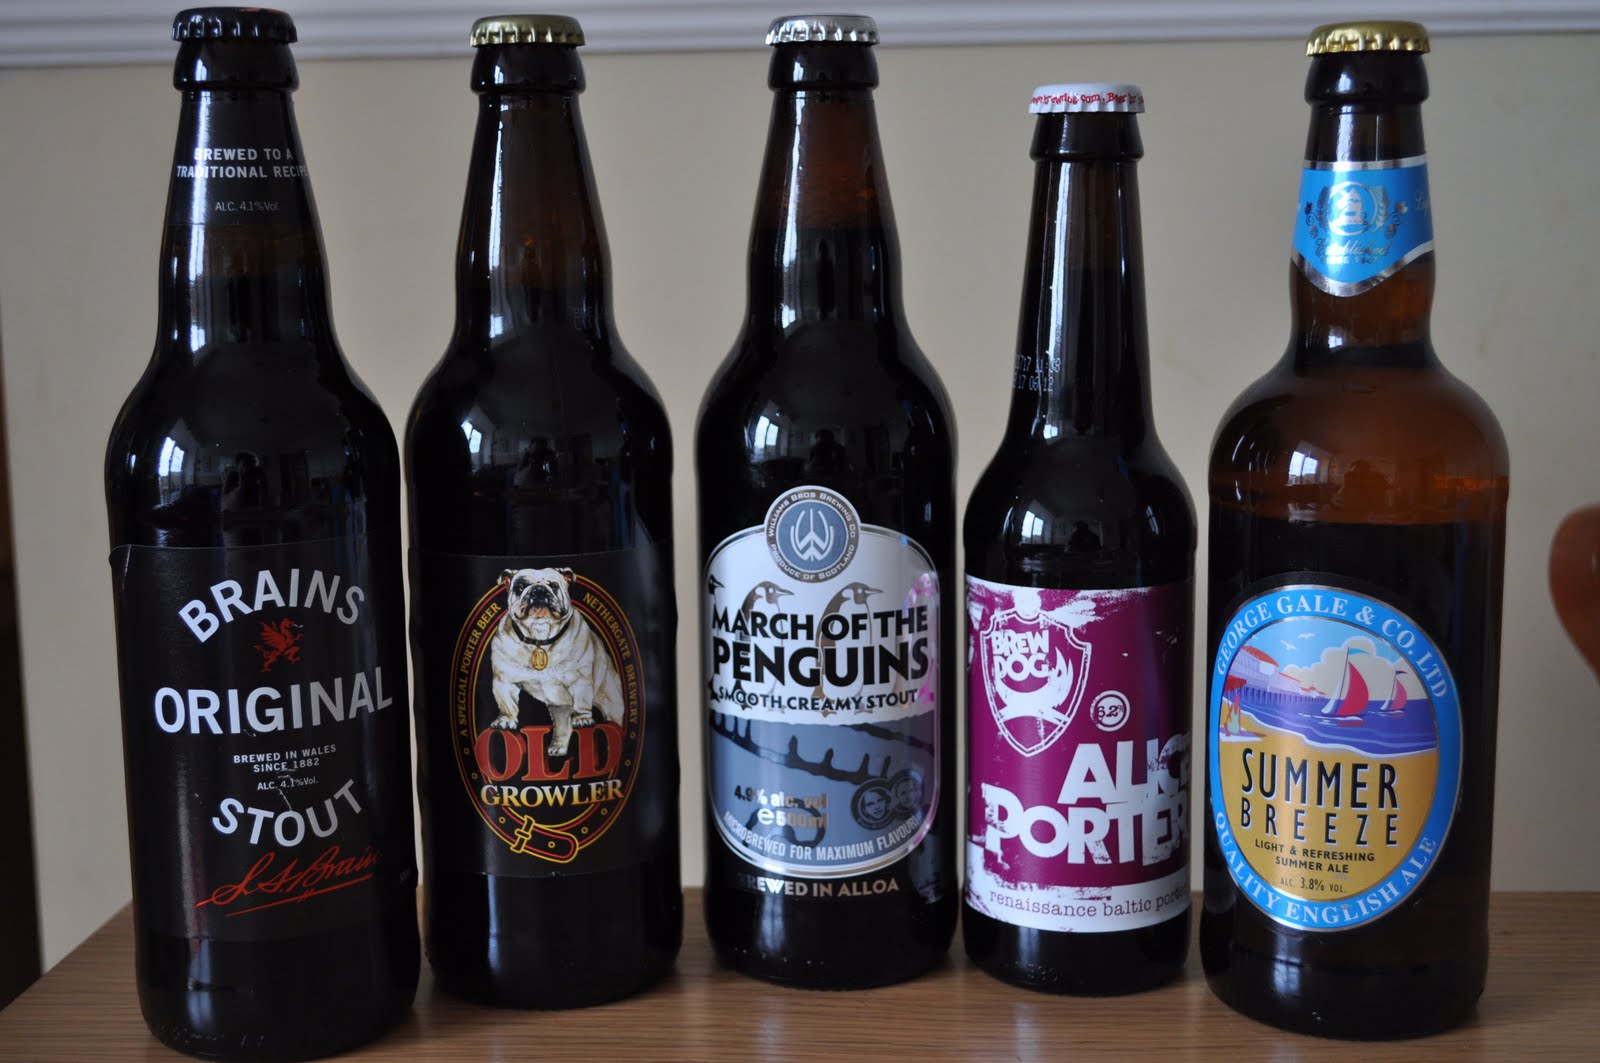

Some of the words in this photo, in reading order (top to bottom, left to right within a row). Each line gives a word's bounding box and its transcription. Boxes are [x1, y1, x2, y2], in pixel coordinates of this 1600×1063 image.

[194, 148, 258, 160] BREWED
[263, 149, 281, 160] TO
[286, 148, 294, 160] A
[176, 166, 267, 178] TRADITIONAL
[215, 201, 237, 212] ALC.
[768, 500, 790, 537] WILLIAMS
[178, 568, 365, 643] BRAINS
[477, 602, 502, 629] BEER
[712, 606, 814, 640] MARCH
[821, 613, 868, 640] OF
[873, 606, 928, 638] THE
[460, 629, 482, 674] PORTER
[991, 629, 1050, 655] BREW
[1217, 601, 1273, 676] GEORGE
[1276, 594, 1350, 617] GALE
[1354, 605, 1376, 626] &
[1382, 618, 1417, 656] CO.
[1416, 652, 1448, 699] LTD
[582, 592, 631, 659] NETHERGATE
[626, 664, 639, 725] BREWERY
[712, 636, 928, 688] PENGUINS
[994, 654, 1051, 682] DOG
[154, 666, 392, 735] ORIGINAL
[458, 672, 468, 726] SPECIAL
[718, 686, 782, 710] SMOOTH
[786, 696, 863, 711] CREAMY
[867, 689, 918, 709] STOUT
[233, 752, 281, 764] BREWED
[285, 750, 298, 760] IN
[302, 744, 336, 758] WALES
[253, 761, 287, 773] SINCE
[292, 758, 320, 769] 1882
[475, 721, 623, 781] OLD
[257, 781, 278, 791] ALC.
[480, 779, 624, 807] GROWLER
[1242, 748, 1400, 811] SUMMER
[212, 778, 362, 847] STOUT
[1240, 796, 1400, 847] BREEZE
[723, 811, 786, 857] MICROBREWED
[789, 844, 812, 860] FOR
[816, 839, 874, 861] MAXIMUM
[1255, 838, 1285, 854] LIGHT
[1290, 844, 1297, 856] &
[1302, 848, 1375, 862] REFRESHING
[1216, 812, 1282, 911] QUALITY
[1284, 880, 1402, 924] ENGLISH
[1400, 837, 1438, 887] ALE
[1275, 856, 1322, 872] SUMMER
[1327, 862, 1350, 874] ALE
[812, 882, 832, 897] IN
[837, 878, 899, 897] ALLOA
[1280, 877, 1296, 888] ALC.
[1300, 877, 1325, 892] 3.8%
[989, 890, 1097, 917] renaissance
[1102, 898, 1152, 918] baltic
[1156, 887, 1188, 912] porte
